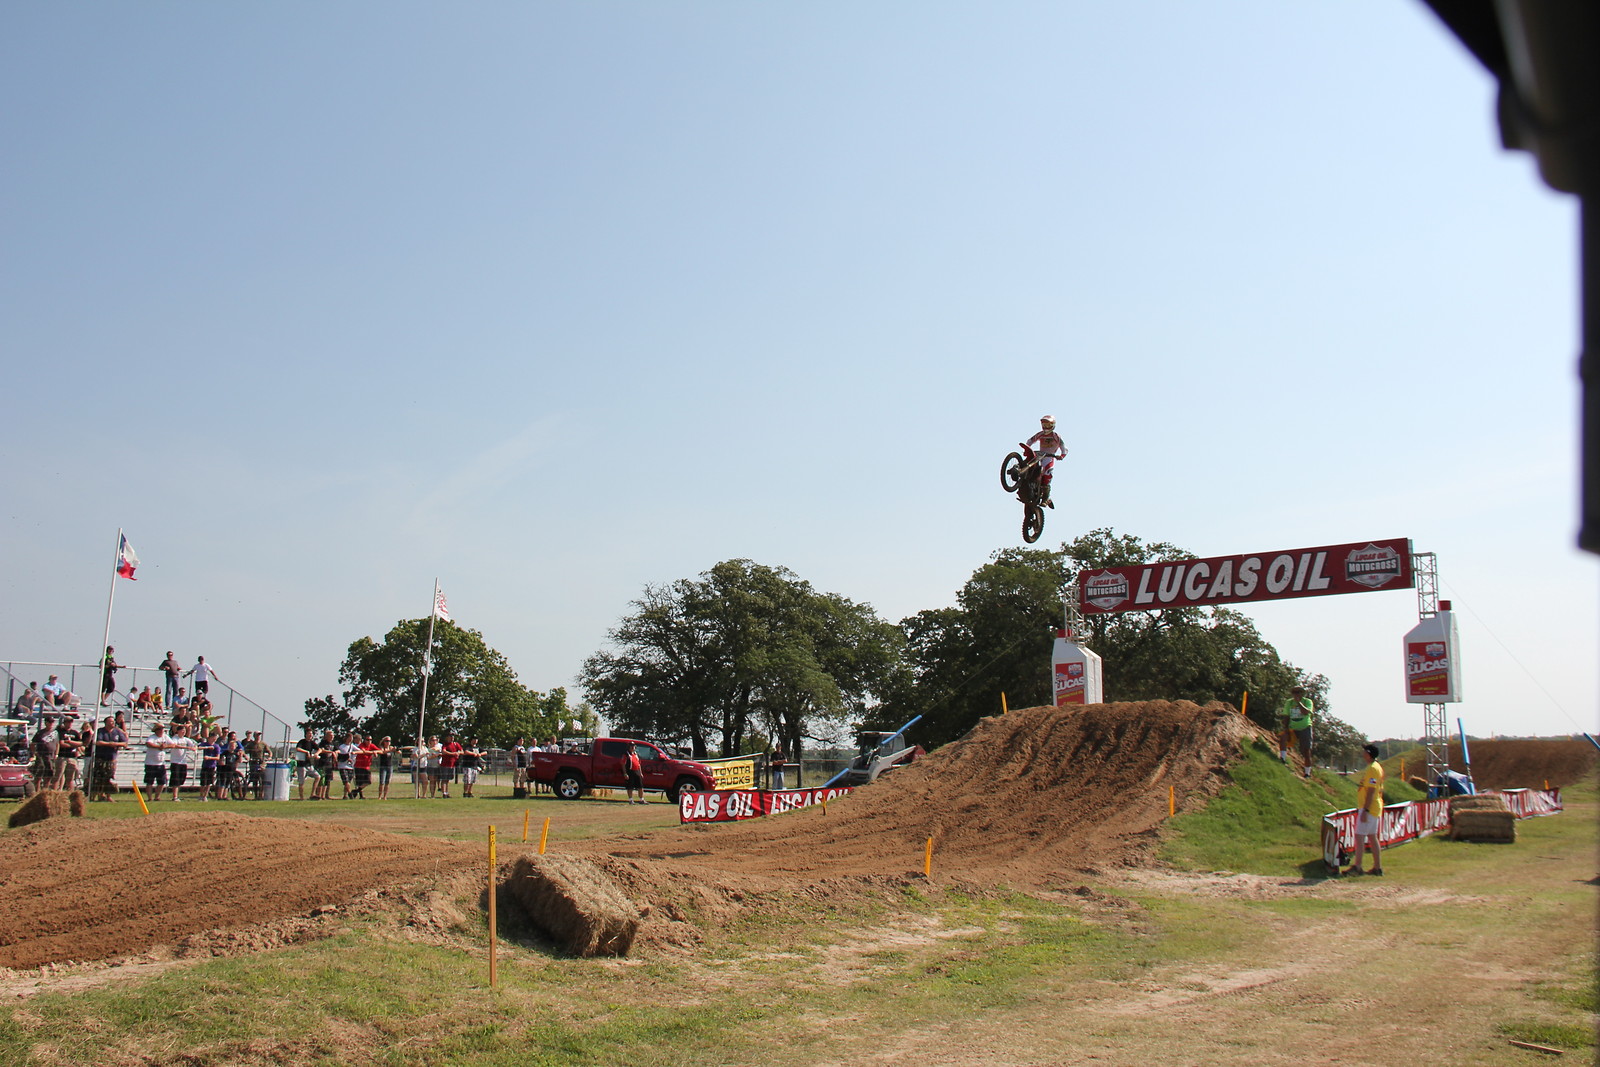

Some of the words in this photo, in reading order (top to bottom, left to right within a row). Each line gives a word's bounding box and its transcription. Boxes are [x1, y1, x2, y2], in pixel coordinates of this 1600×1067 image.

[1348, 559, 1397, 572] MOTOCROSS
[1134, 557, 1262, 604] LUCAS
[1266, 552, 1331, 594] OIL
[1087, 584, 1126, 596] MOTOCROSS
[1408, 658, 1448, 675] LUCAS
[1055, 676, 1085, 691] LUCAS
[713, 765, 751, 776] TOYOTA
[715, 775, 751, 787] TRUCKS
[682, 793, 720, 819] CAS
[726, 792, 754, 818] OIL
[771, 791, 823, 815] LUCAS
